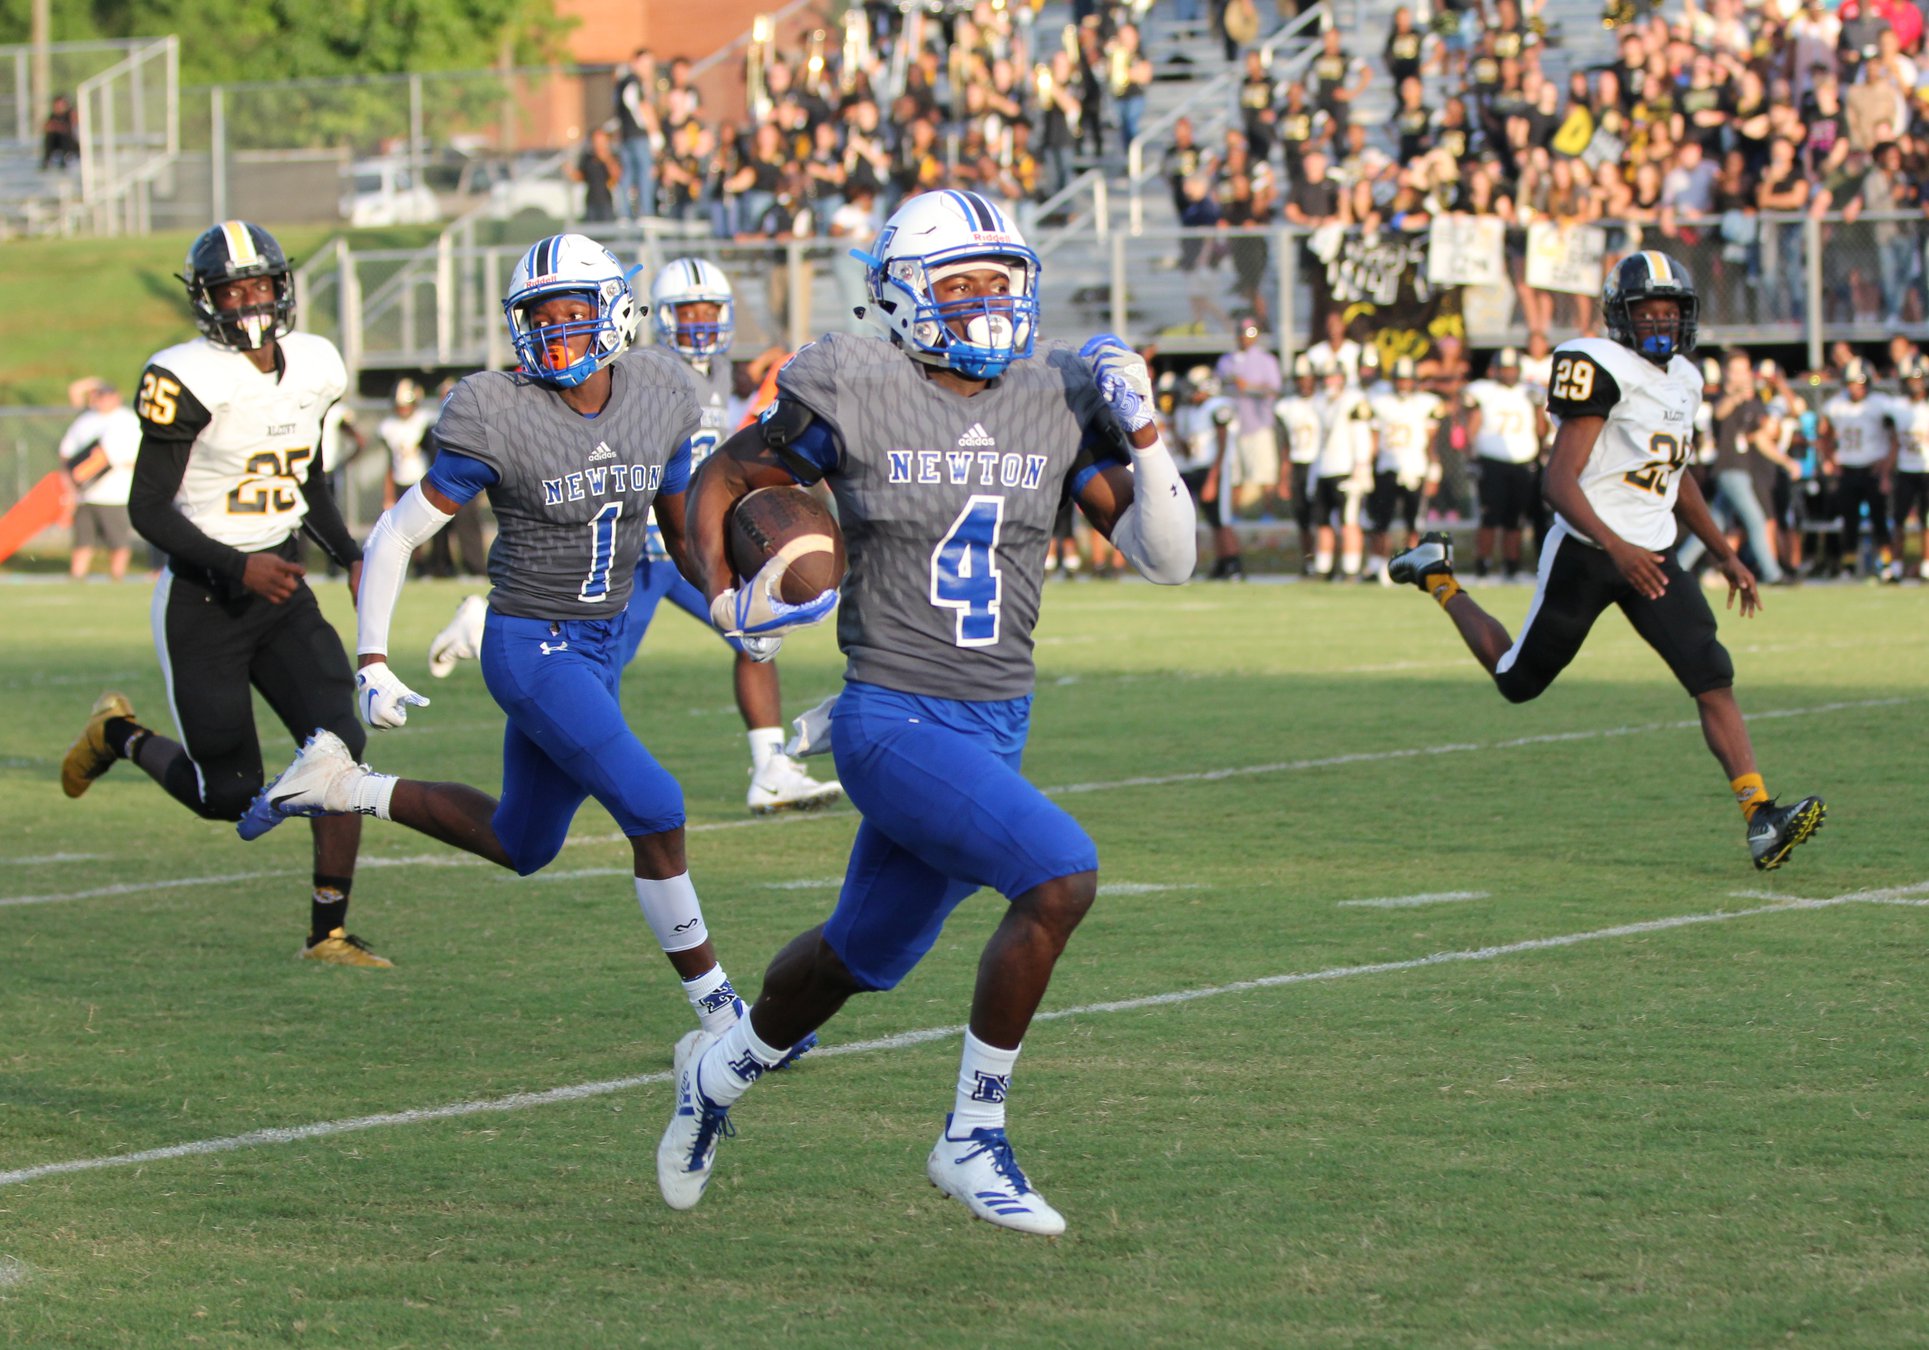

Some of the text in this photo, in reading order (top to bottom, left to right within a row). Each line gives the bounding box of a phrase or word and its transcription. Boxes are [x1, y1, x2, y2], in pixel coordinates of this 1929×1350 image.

[138, 373, 181, 425] 25
[1553, 358, 1596, 401] 29
[588, 450, 617, 462] adidas
[958, 437, 995, 447] adidas
[543, 464, 662, 506] NEWTON
[887, 450, 1048, 489] NEWTON
[577, 500, 624, 603] 1
[930, 494, 1006, 648] 4
